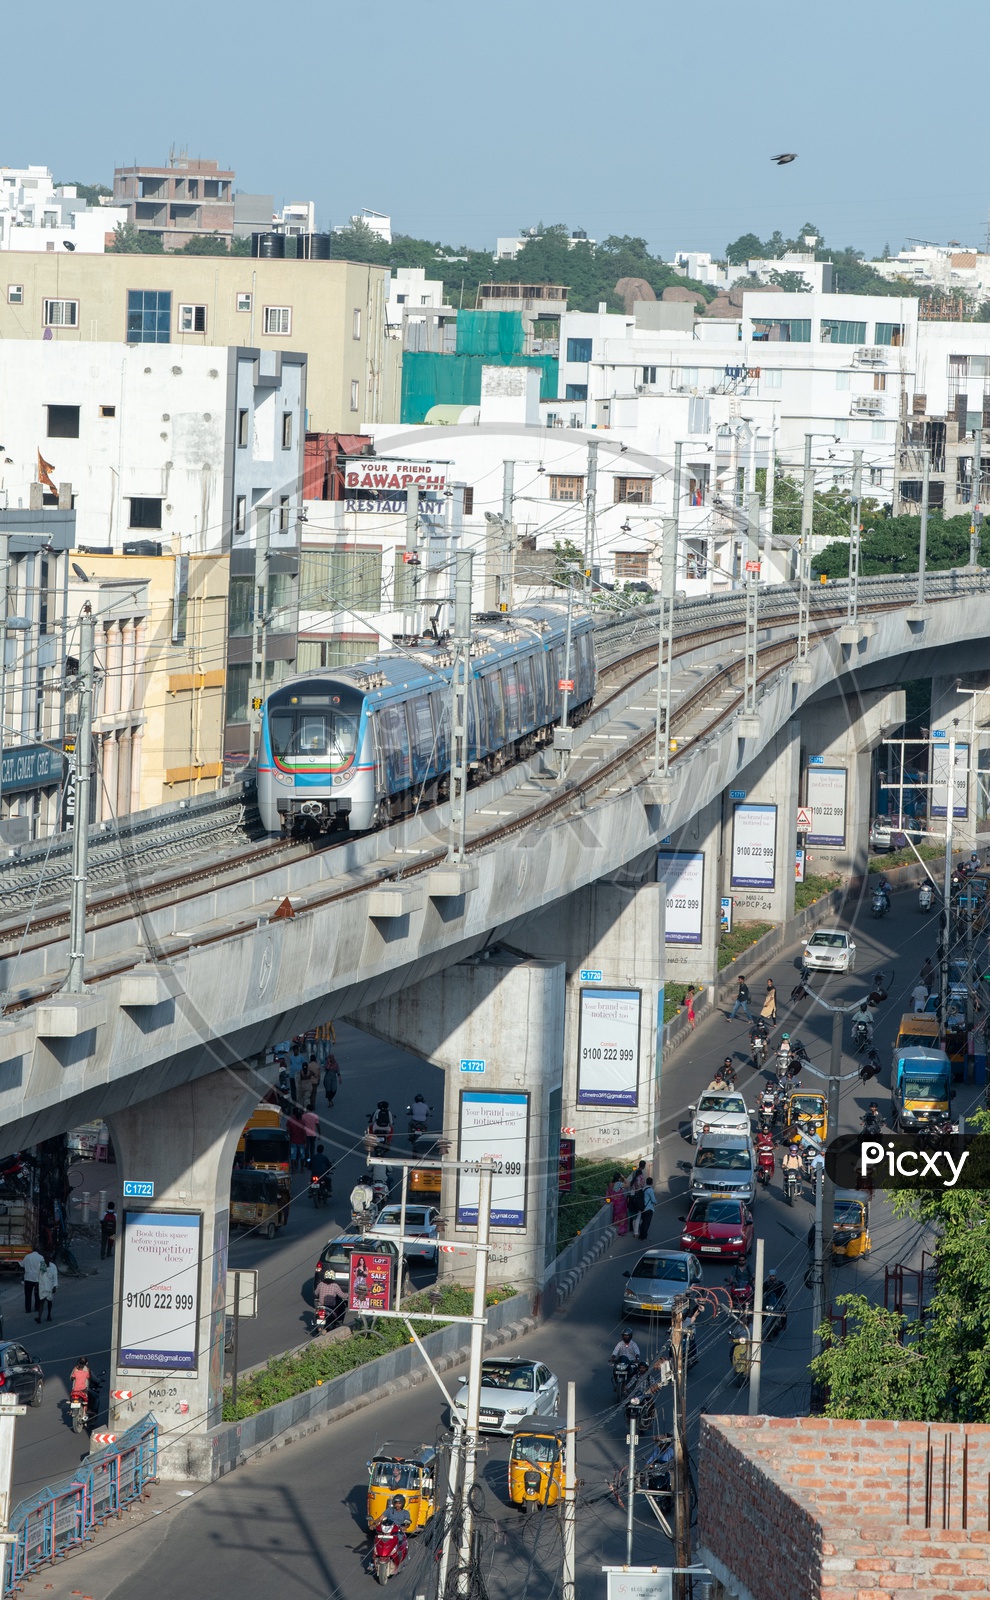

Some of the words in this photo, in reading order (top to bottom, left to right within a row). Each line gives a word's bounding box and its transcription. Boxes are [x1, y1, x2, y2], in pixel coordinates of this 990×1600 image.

[361, 464, 388, 472] YOUR
[346, 500, 445, 514] RESTAUANT
[737, 847, 750, 855] 9100
[752, 847, 762, 856] 222
[763, 848, 773, 856] 999
[675, 900, 686, 908] 222
[688, 900, 698, 909] 999
[598, 1002, 618, 1010] brand
[583, 1048, 601, 1060] 9100
[604, 1049, 617, 1060] 222
[620, 1049, 634, 1060] 999
[481, 1107, 504, 1116] brand
[474, 1117, 502, 1126] noticed
[506, 1162, 521, 1175] 999
[138, 1244, 194, 1255] competitor
[127, 1293, 150, 1308] 9100
[154, 1294, 172, 1309] 222
[175, 1294, 193, 1310] 999
[125, 1353, 191, 1363] cfmetro365@gmail.com
